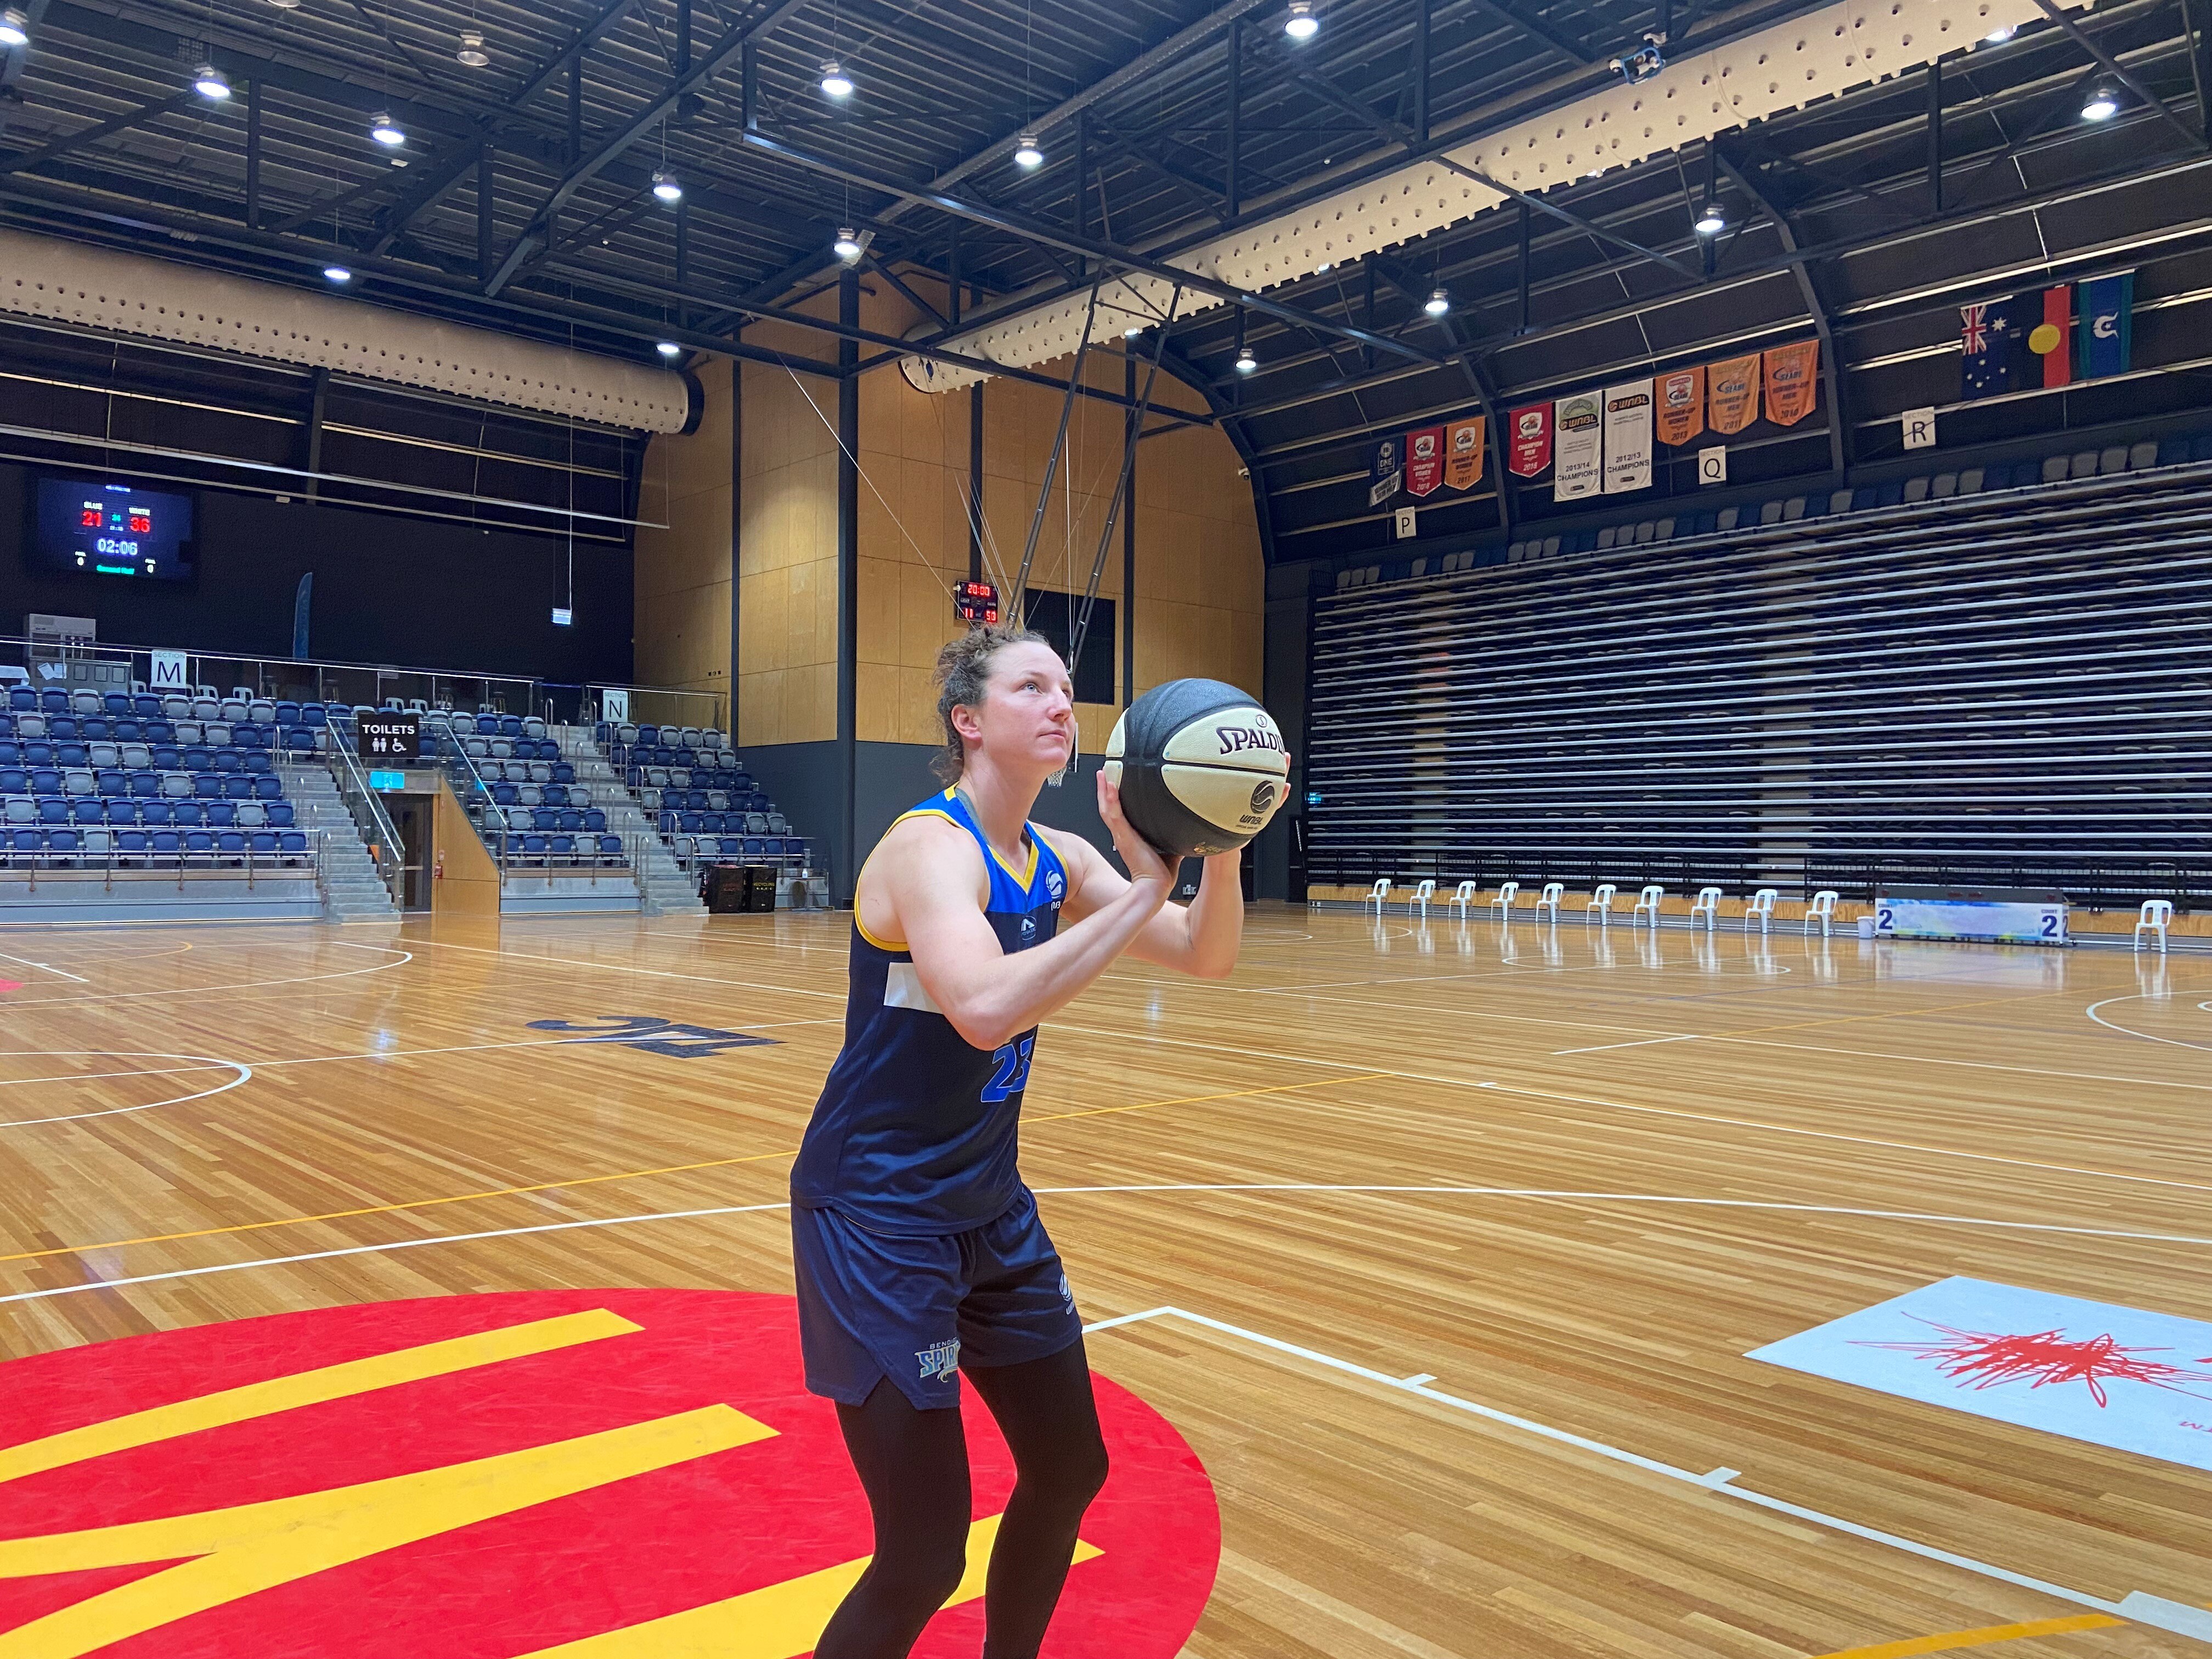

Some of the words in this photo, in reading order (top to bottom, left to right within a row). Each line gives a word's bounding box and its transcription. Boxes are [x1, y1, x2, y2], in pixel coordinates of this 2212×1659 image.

[1912, 421, 1926, 443] R
[1616, 452, 1641, 463] 2012/13
[1565, 462, 1590, 472] 2013/14
[1607, 460, 1650, 473] CHAMPIONS
[1704, 458, 1721, 478] Q
[1557, 469, 1599, 481] CHAMPIONS
[83, 501, 103, 510] BLUE
[82, 511, 102, 527] 21
[129, 517, 151, 533] 36
[1402, 517, 1410, 534] P
[97, 538, 138, 556] 02:06
[967, 584, 990, 597] 20:00
[986, 610, 997, 621] 50
[157, 661, 180, 683] M
[610, 700, 622, 718] N
[362, 724, 415, 735] TOILETS
[1878, 909, 1893, 930] 2
[2042, 915, 2057, 937] 2
[981, 1035, 1034, 1103] 23
